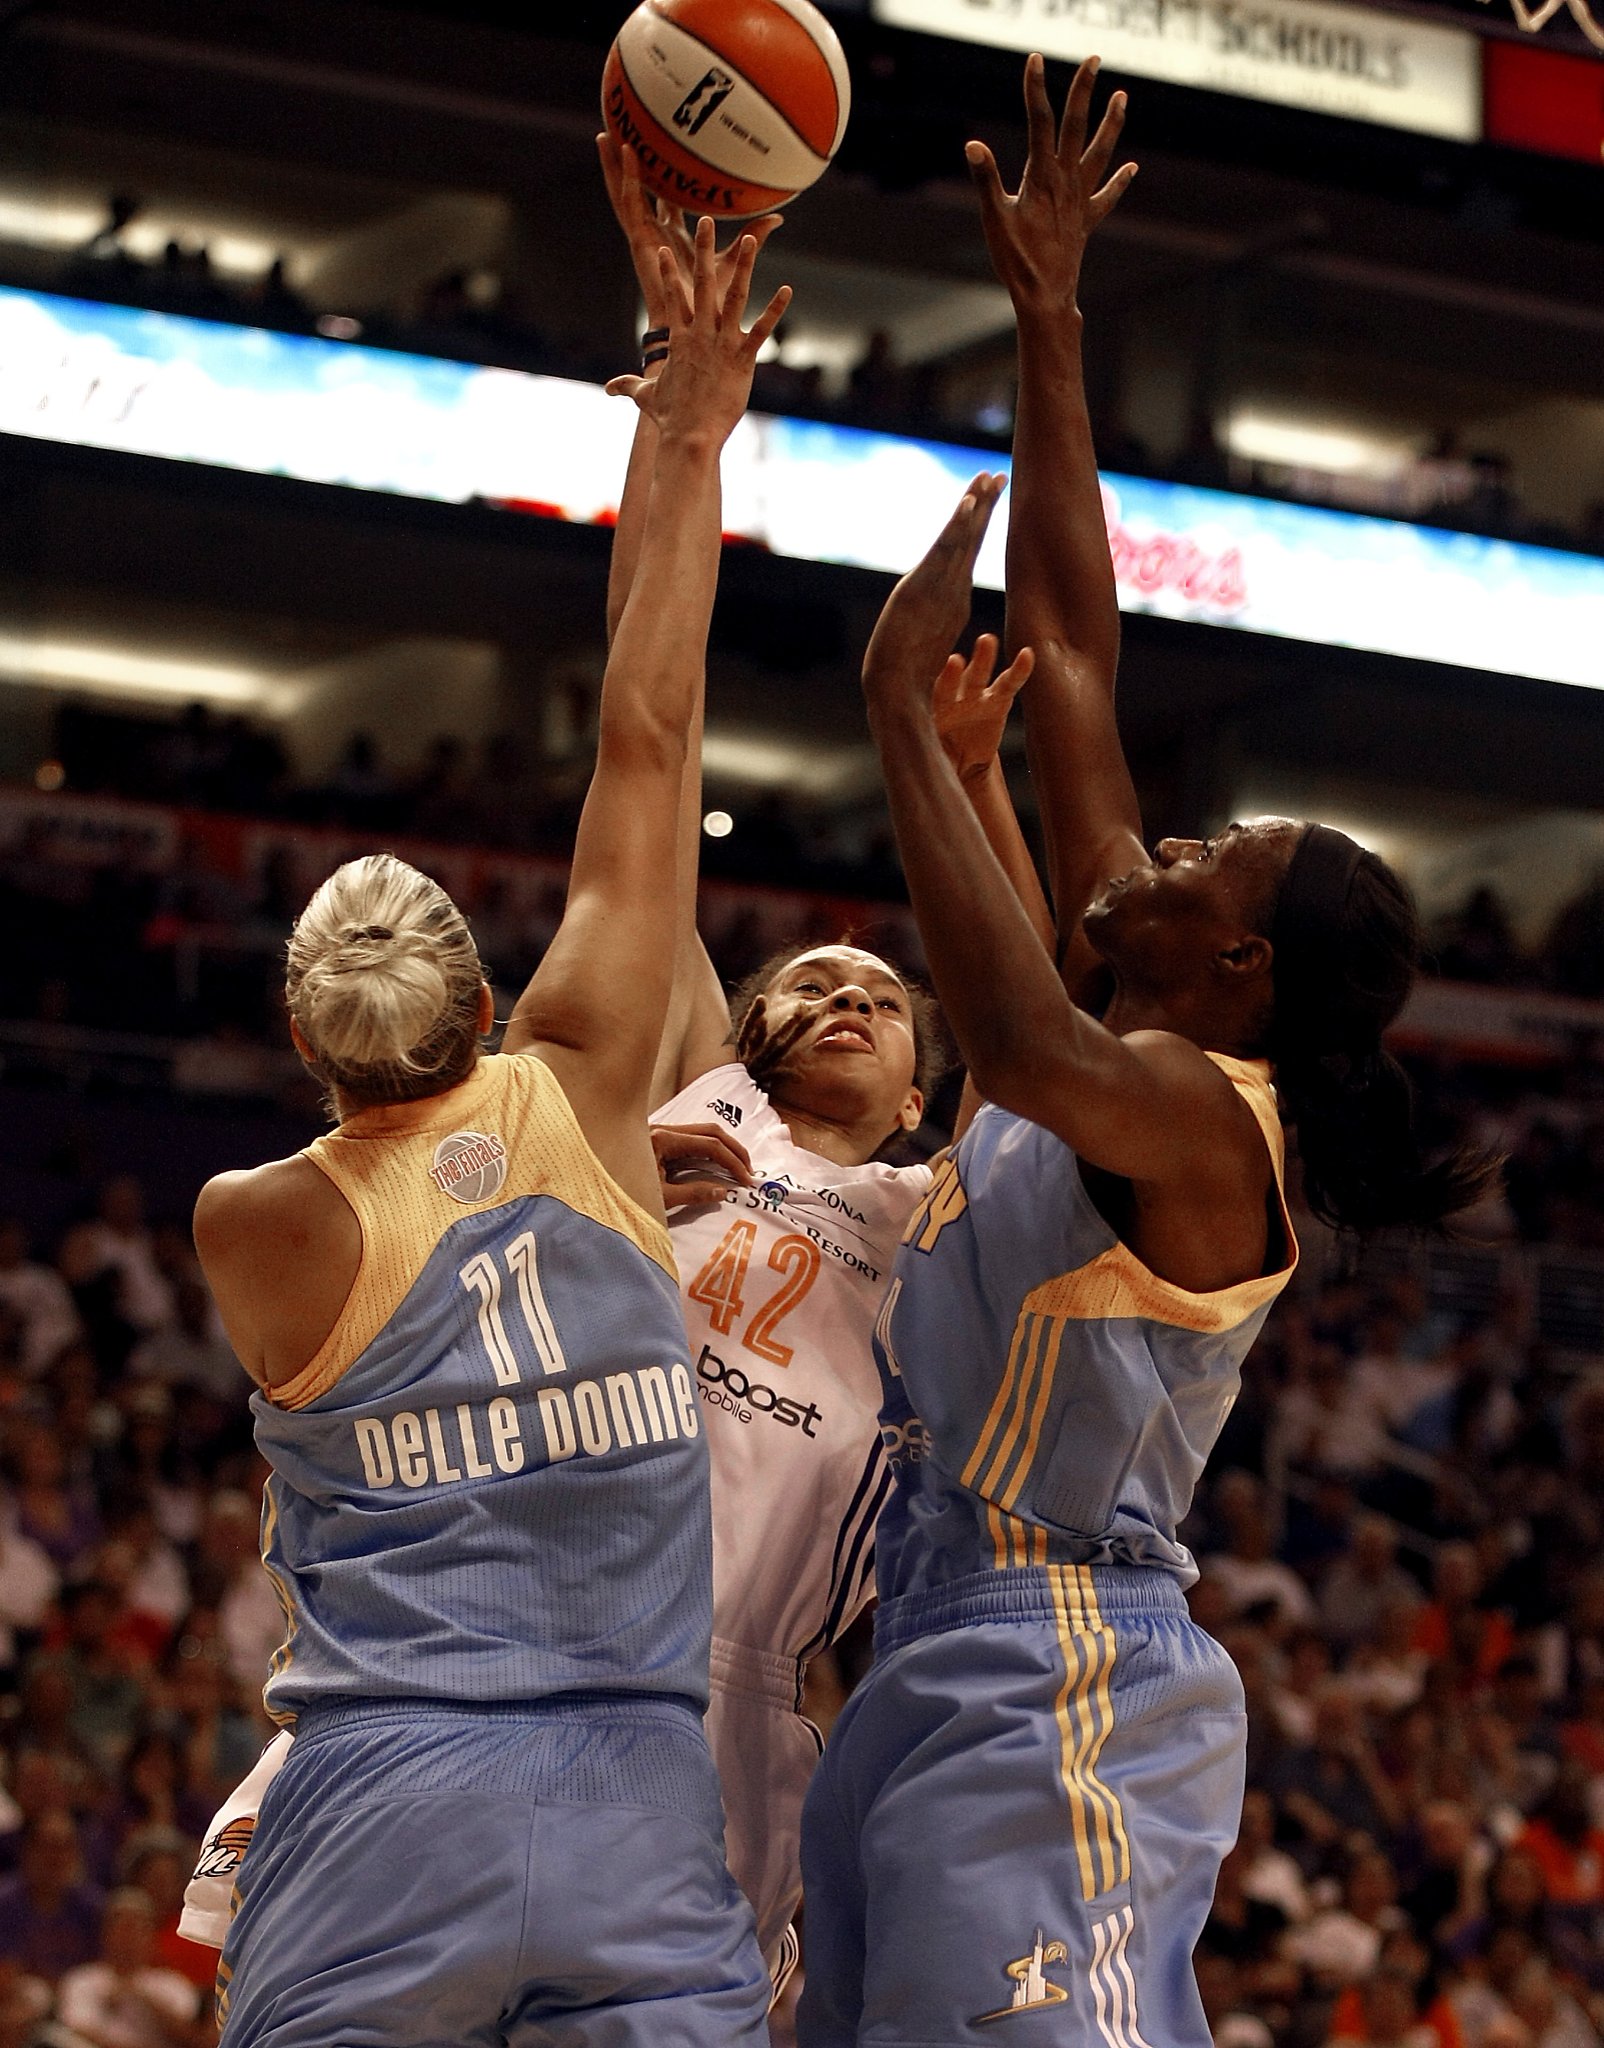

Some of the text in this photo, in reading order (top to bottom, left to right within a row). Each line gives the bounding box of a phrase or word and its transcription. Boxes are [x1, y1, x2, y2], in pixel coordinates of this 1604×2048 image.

[610, 84, 744, 208] SPALDING
[458, 1230, 567, 1387] 11
[687, 1218, 822, 1369] 42
[806, 1225, 882, 1282] RESORT
[696, 1343, 823, 1440] boost
